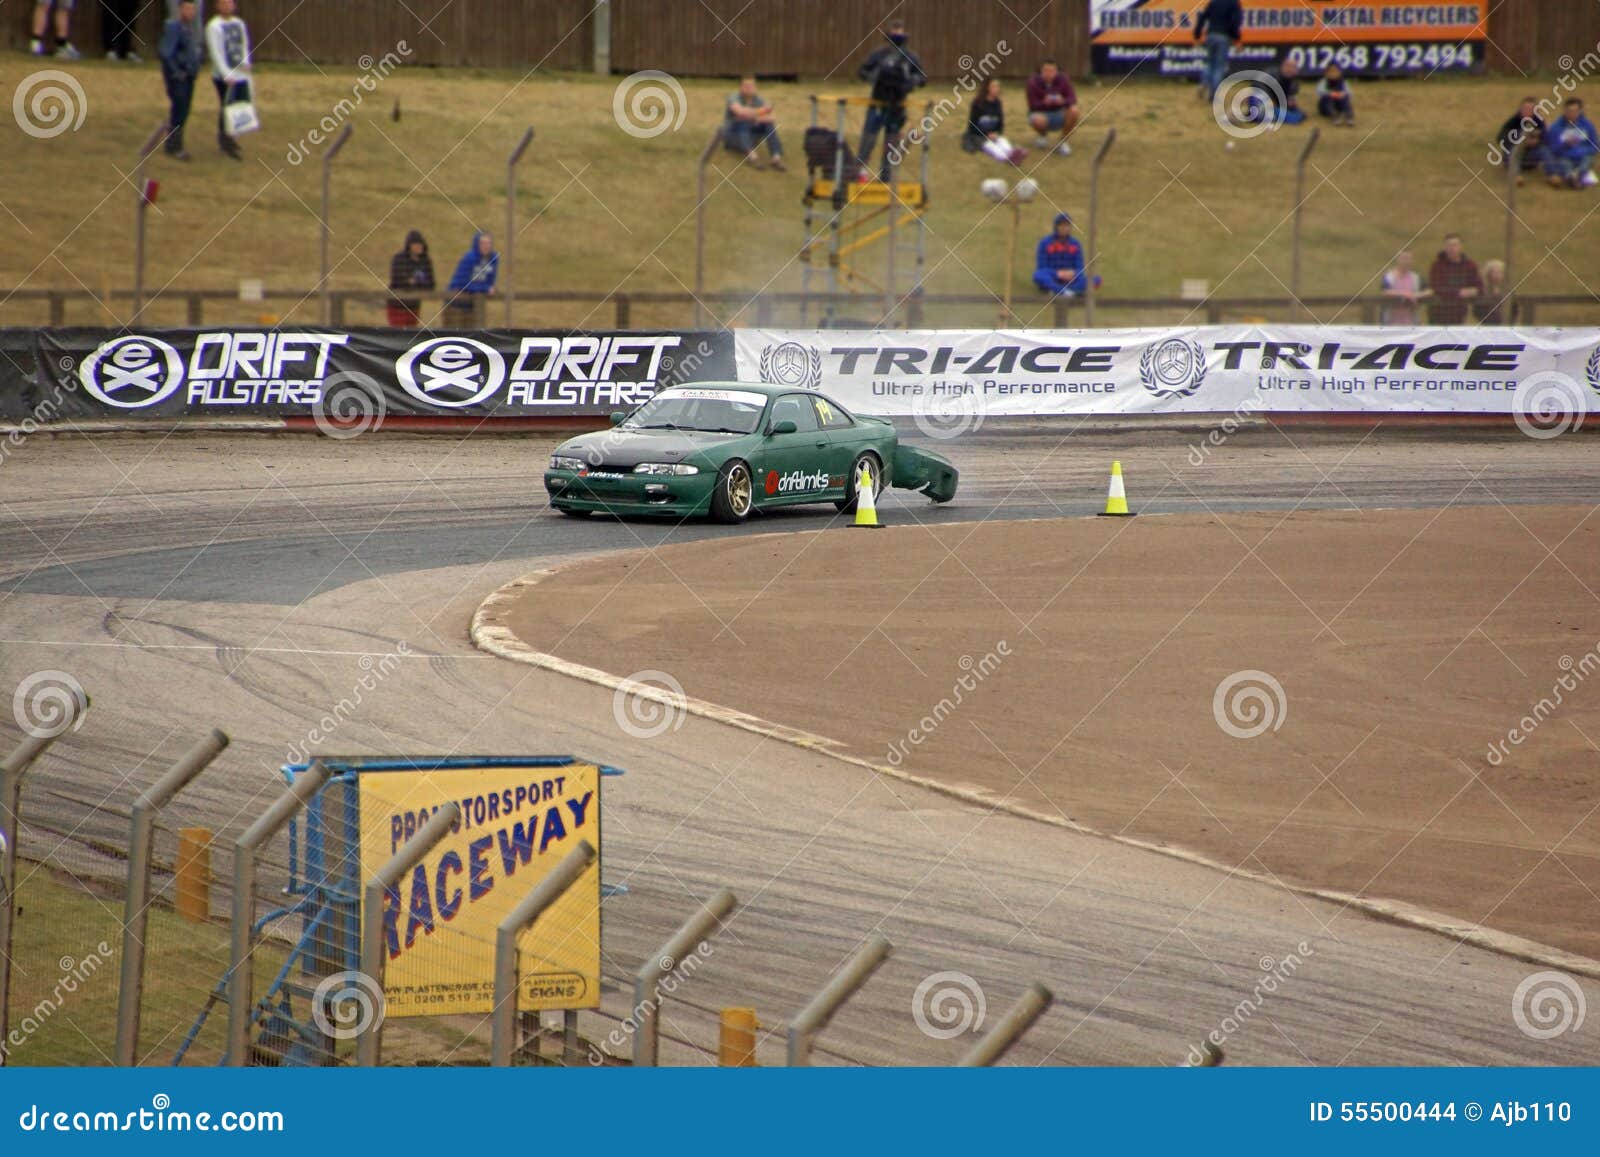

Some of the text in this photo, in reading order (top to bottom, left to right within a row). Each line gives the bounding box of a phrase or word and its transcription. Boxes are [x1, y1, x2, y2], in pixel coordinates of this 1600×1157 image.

[1101, 9, 1175, 28] FERROUS
[1323, 8, 1375, 25] METAL
[1380, 6, 1479, 25] RECYCLERS
[1289, 45, 1474, 68] 01268 792494
[188, 333, 349, 379] DRIFT
[510, 336, 681, 381] DRIFT
[830, 346, 1121, 374] TRI-ACE
[1214, 342, 1526, 370] TRI-ACE
[187, 379, 324, 405] ALLSTARS
[507, 381, 656, 405] ALLSTARS
[873, 380, 1115, 397] Ultra High Performance
[1258, 376, 1517, 394] Ultra High Performance
[383, 790, 593, 961] RACEWAY
[530, 986, 575, 999] SIGNS
